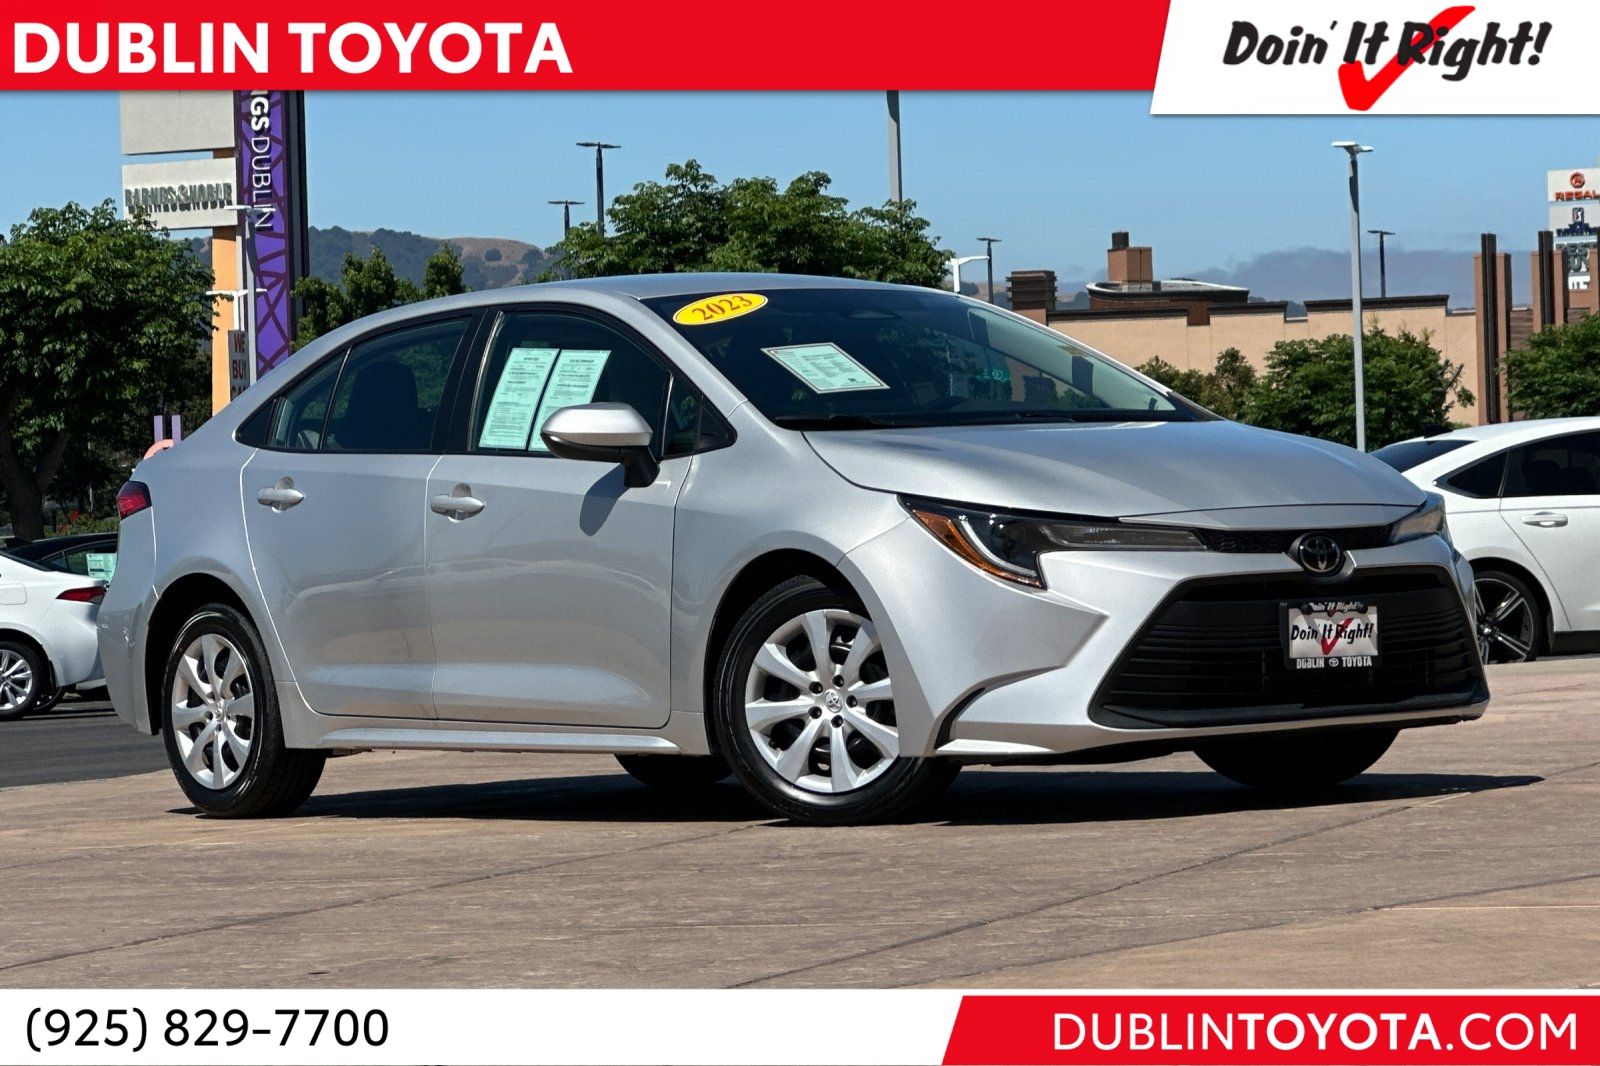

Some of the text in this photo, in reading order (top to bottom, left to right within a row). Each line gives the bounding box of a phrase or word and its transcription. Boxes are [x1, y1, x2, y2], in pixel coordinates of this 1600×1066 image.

[250, 89, 273, 227] GS DUBLIN
[692, 295, 752, 321] 2023
[1322, 623, 1333, 639] It
[1336, 623, 1374, 644] Right!
[1296, 656, 1373, 669] DUBLIN TOYOTA
